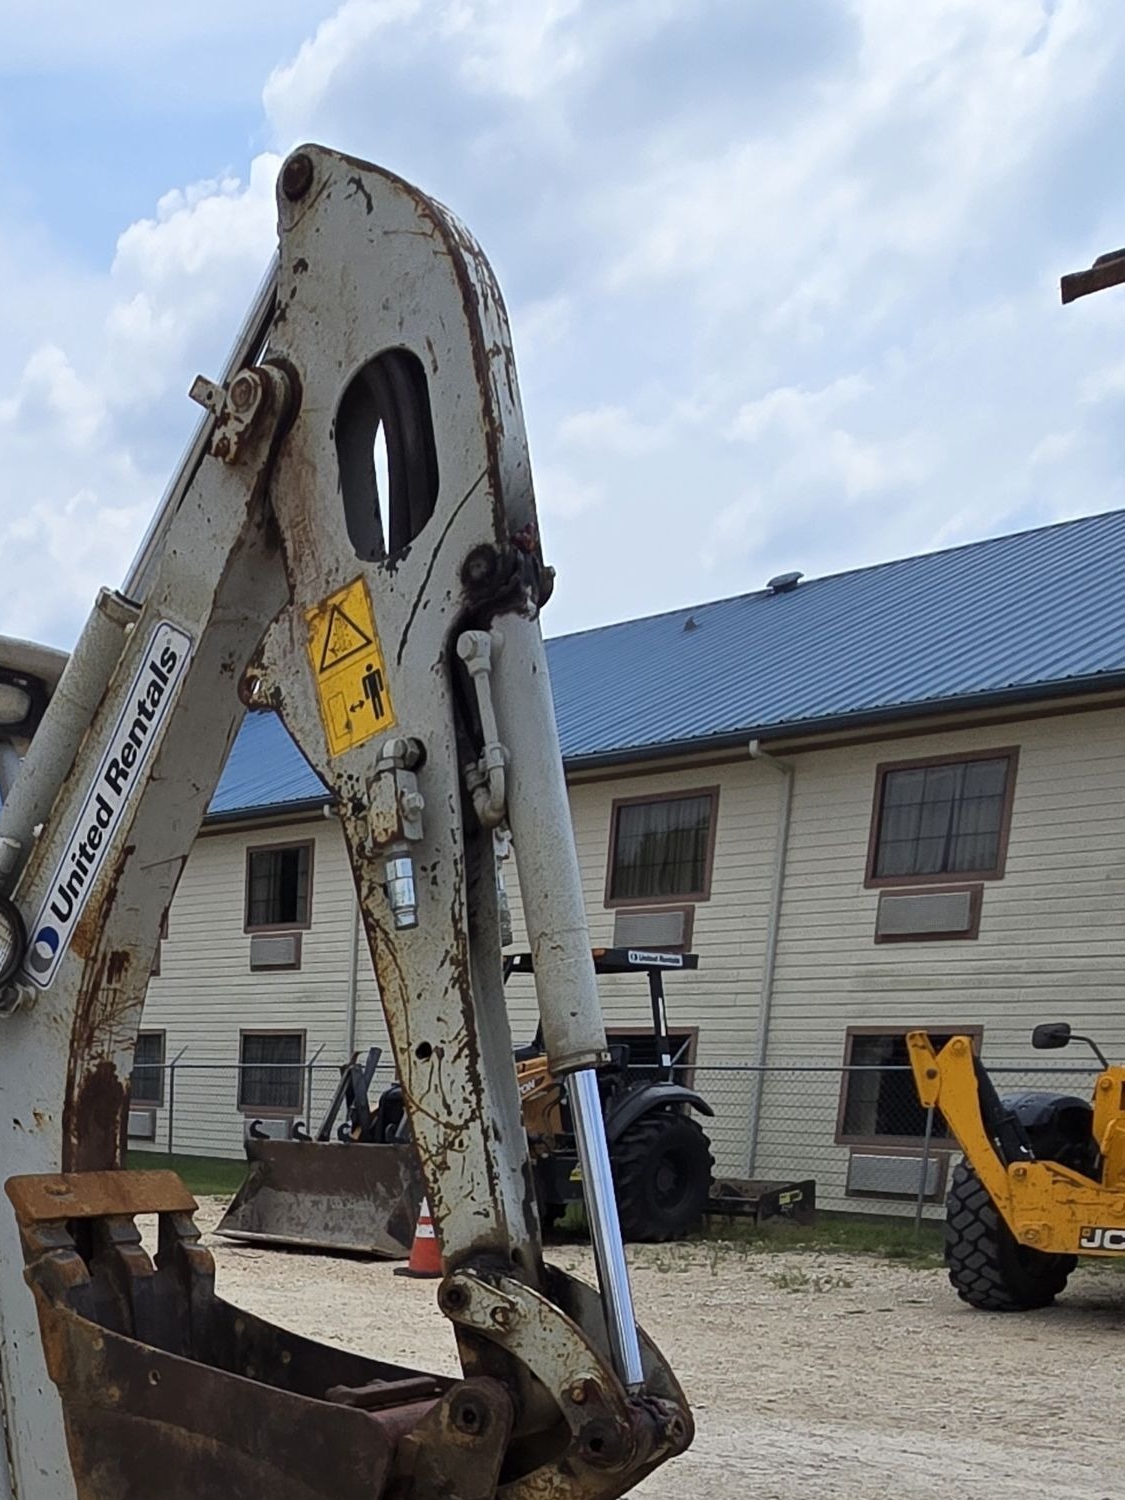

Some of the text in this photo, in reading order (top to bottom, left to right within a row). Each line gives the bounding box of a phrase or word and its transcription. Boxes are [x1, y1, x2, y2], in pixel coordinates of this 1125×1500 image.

[49, 644, 177, 924] United Rentals
[1080, 1228, 1125, 1249] JC
